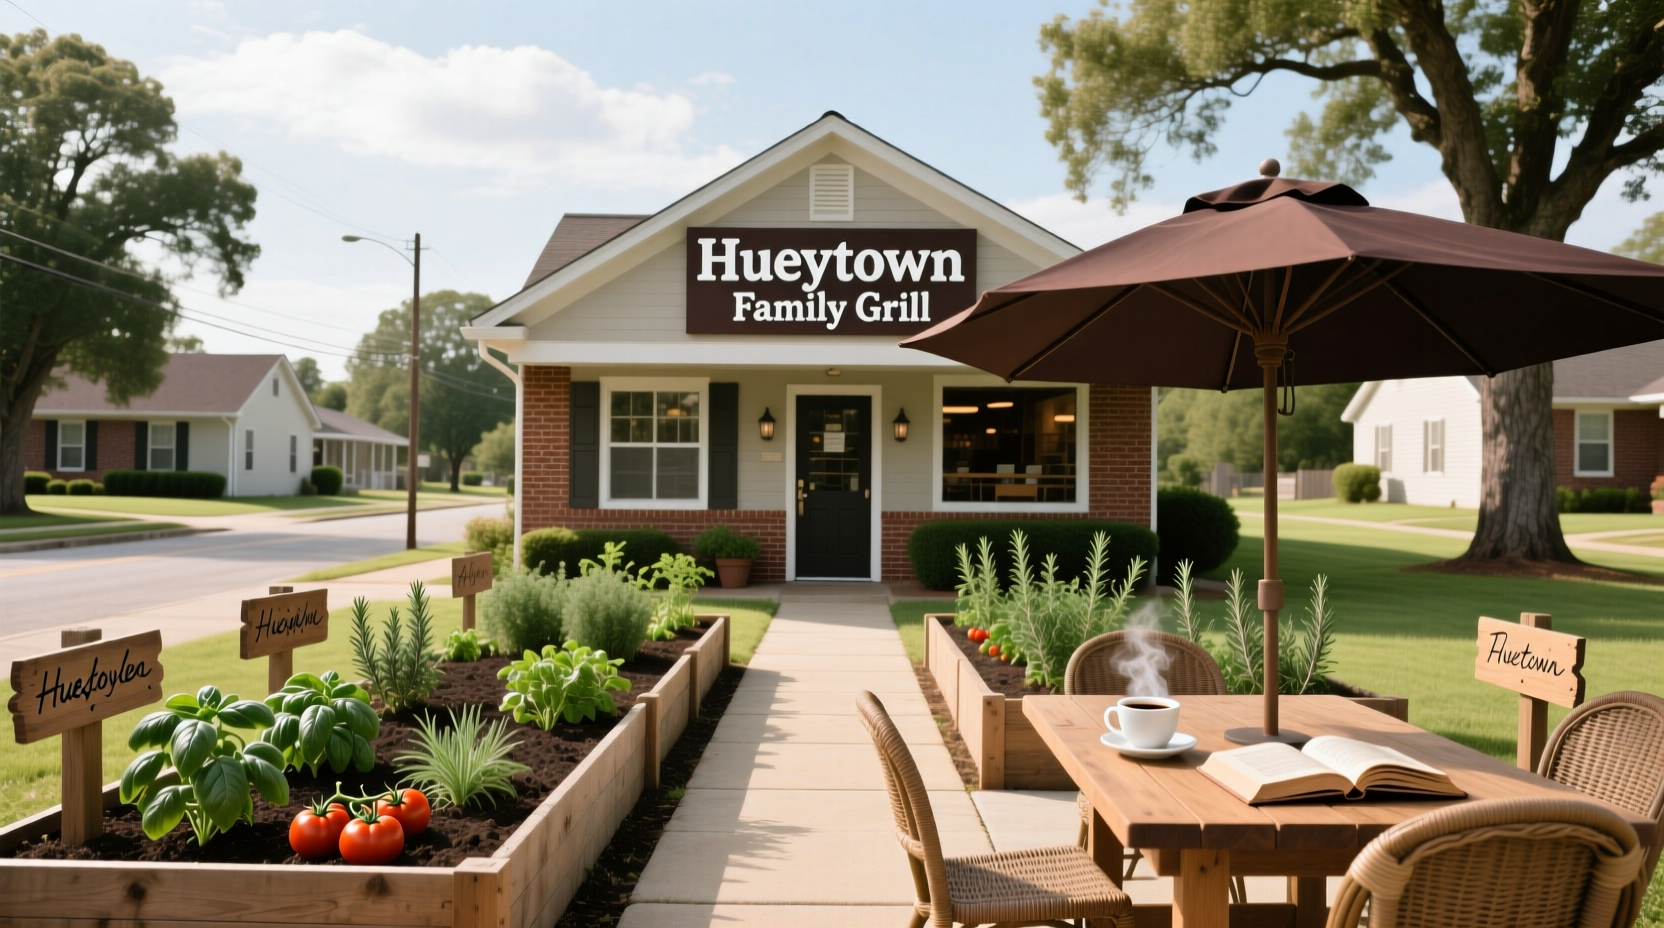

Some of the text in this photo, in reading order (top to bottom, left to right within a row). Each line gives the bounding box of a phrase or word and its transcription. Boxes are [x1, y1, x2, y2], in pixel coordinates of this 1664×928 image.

[697, 238, 965, 292] Hueytown
[733, 291, 931, 330] Family Grill
